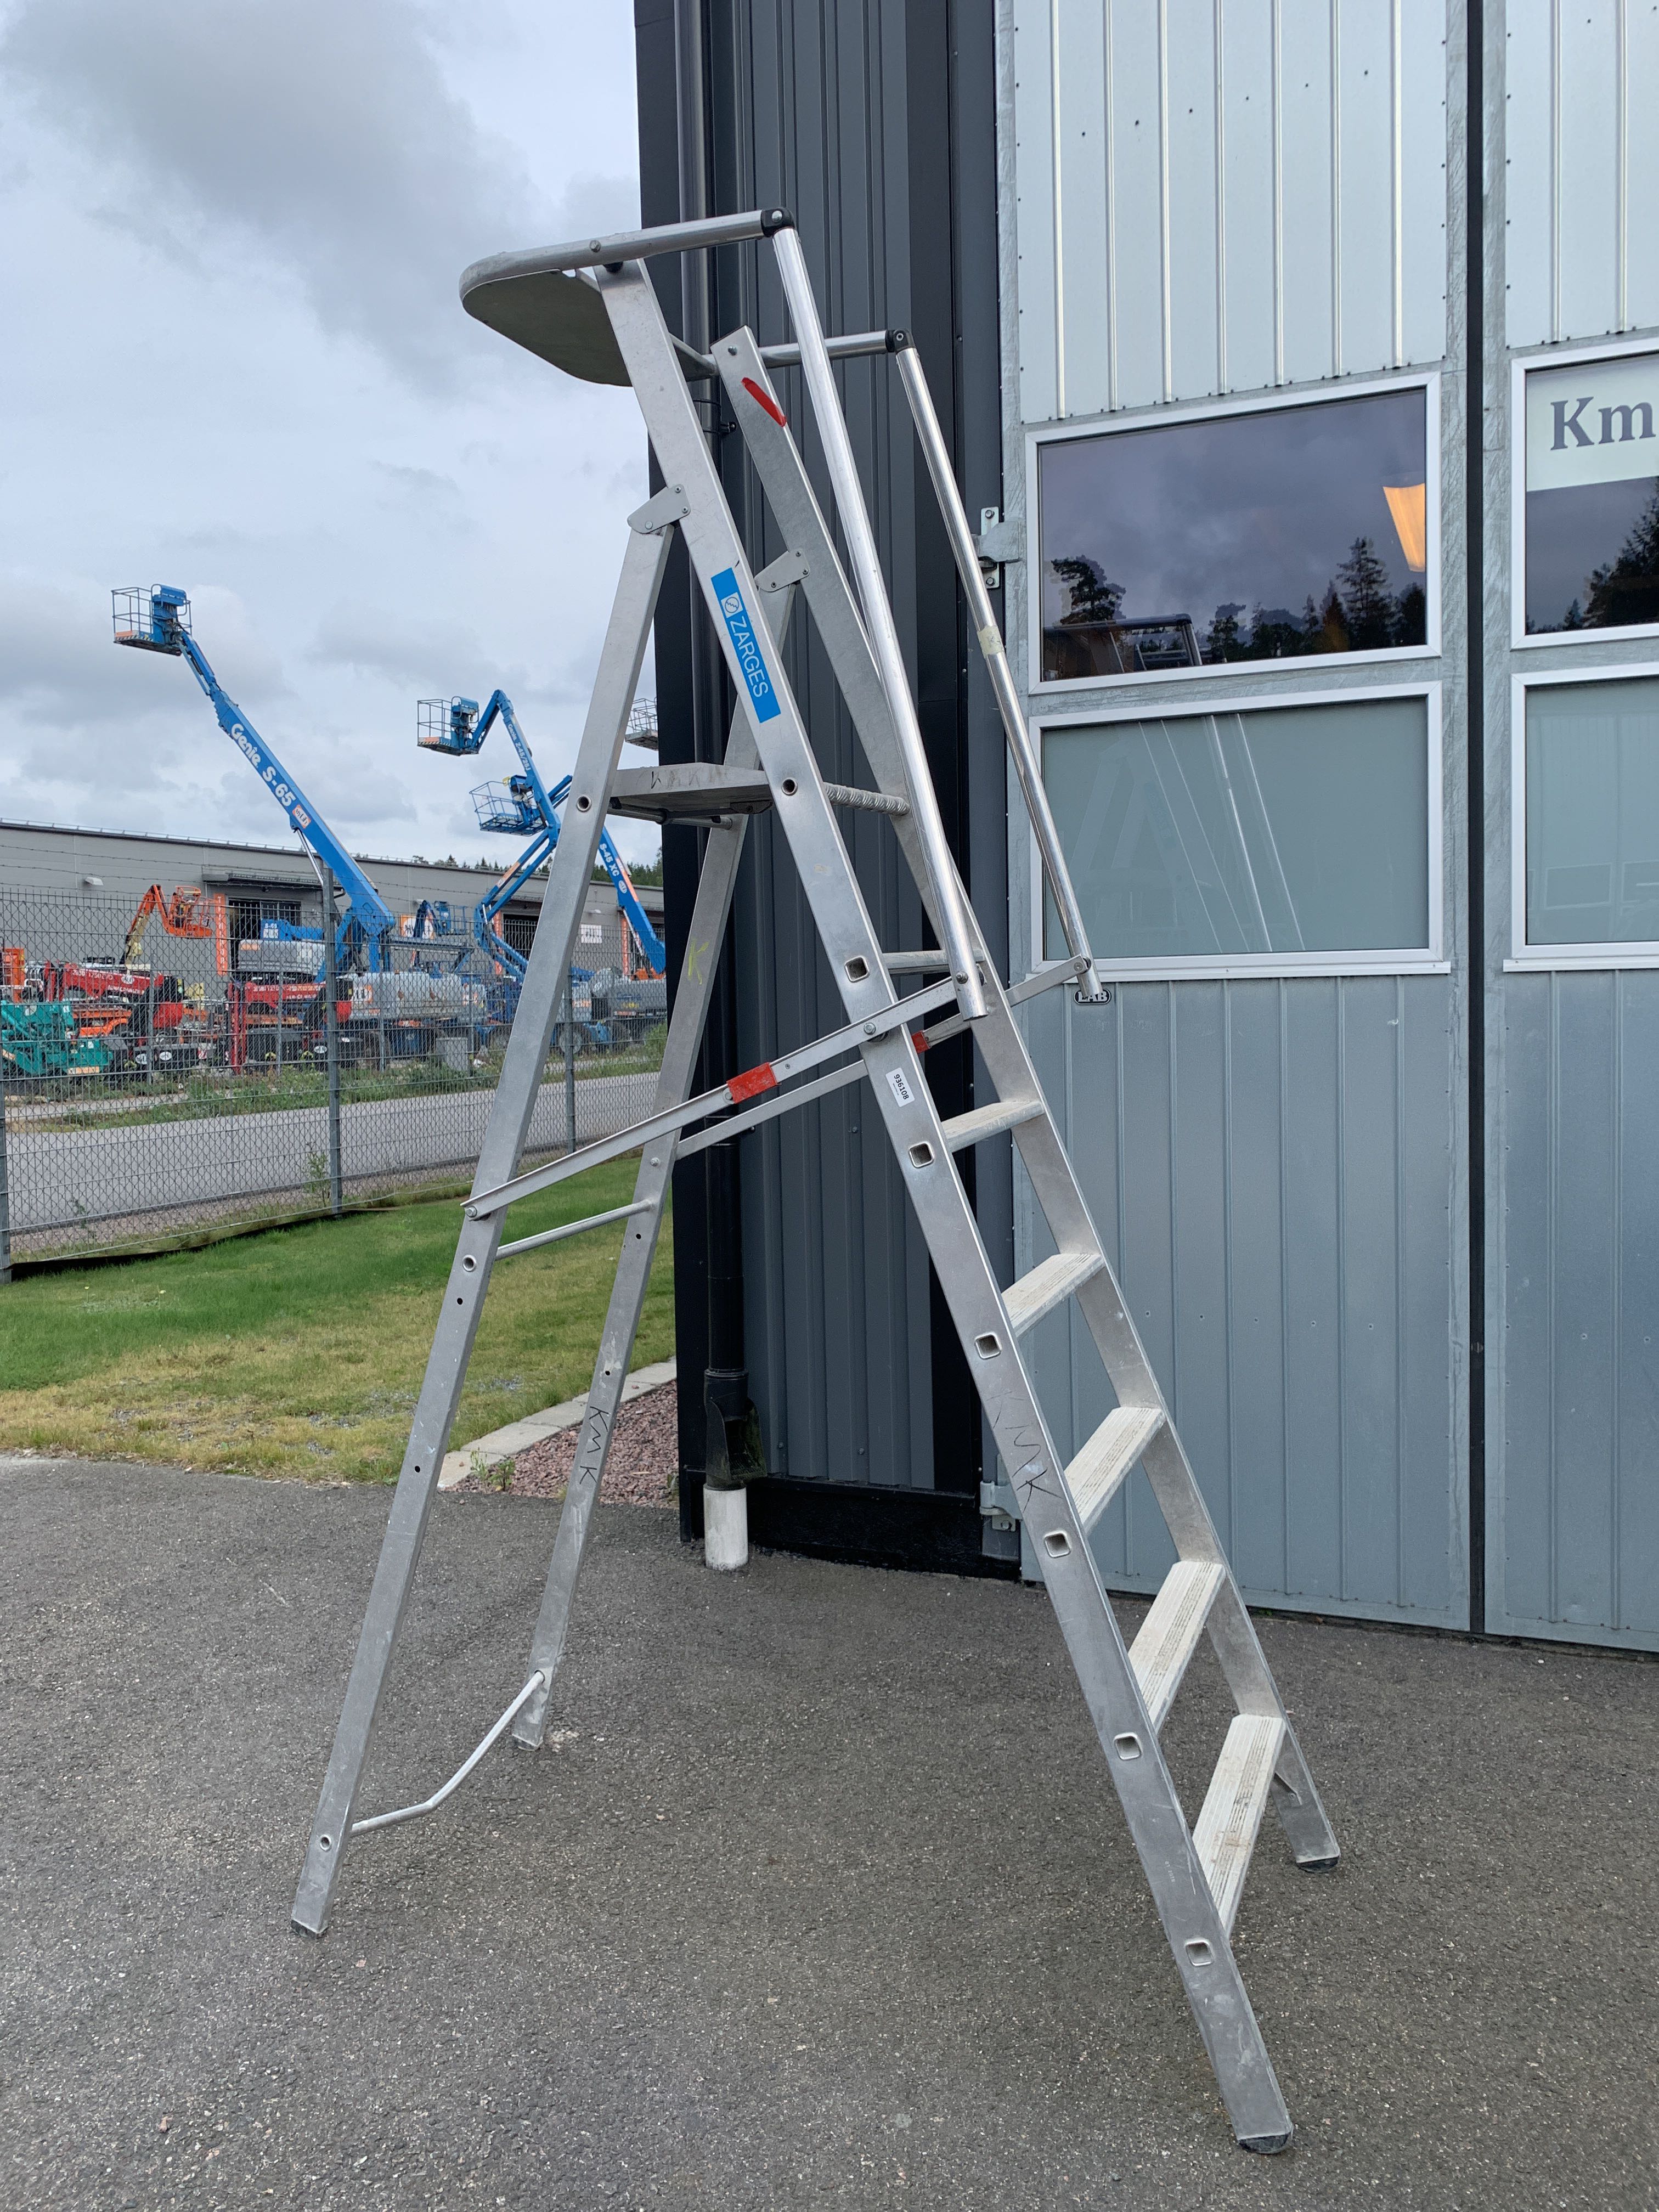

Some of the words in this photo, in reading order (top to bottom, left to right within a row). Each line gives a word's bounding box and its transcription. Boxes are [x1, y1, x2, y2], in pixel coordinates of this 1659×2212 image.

[730, 616, 769, 697] ZARGES
[508, 724, 517, 742] Genie
[232, 723, 261, 768] Genie
[262, 766, 296, 806] S-65
[600, 843, 613, 863] S-45
[609, 863, 620, 876] XC
[1078, 991, 1108, 1002] LAB
[894, 1074, 909, 1099] 936108
